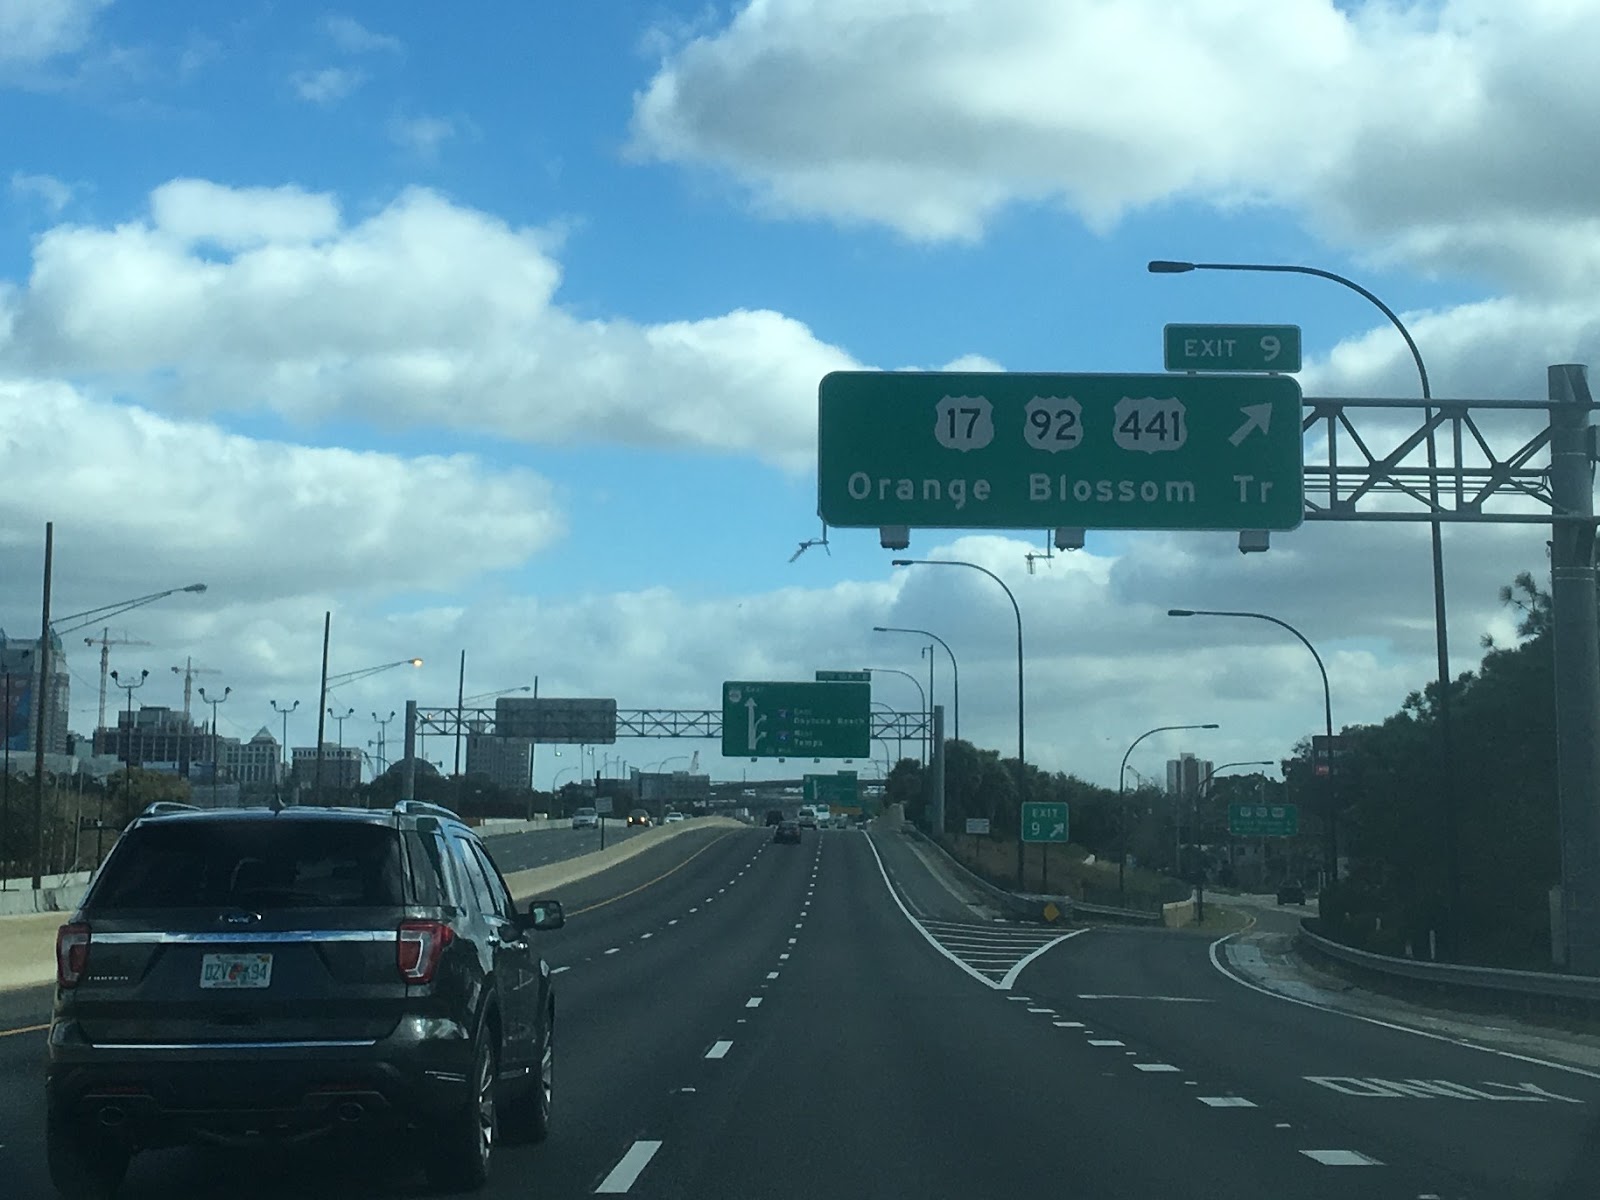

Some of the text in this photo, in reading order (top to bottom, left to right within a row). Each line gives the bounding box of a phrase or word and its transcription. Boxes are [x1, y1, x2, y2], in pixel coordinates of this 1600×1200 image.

[1184, 335, 1282, 362] EXIT 9
[946, 407, 981, 440] 17
[1029, 409, 1077, 441] 92
[1118, 409, 1181, 442] 441
[847, 471, 1274, 510] Orange Blossom Tr
[1031, 821, 1041, 836] 9
[1032, 808, 1058, 818] EXIT
